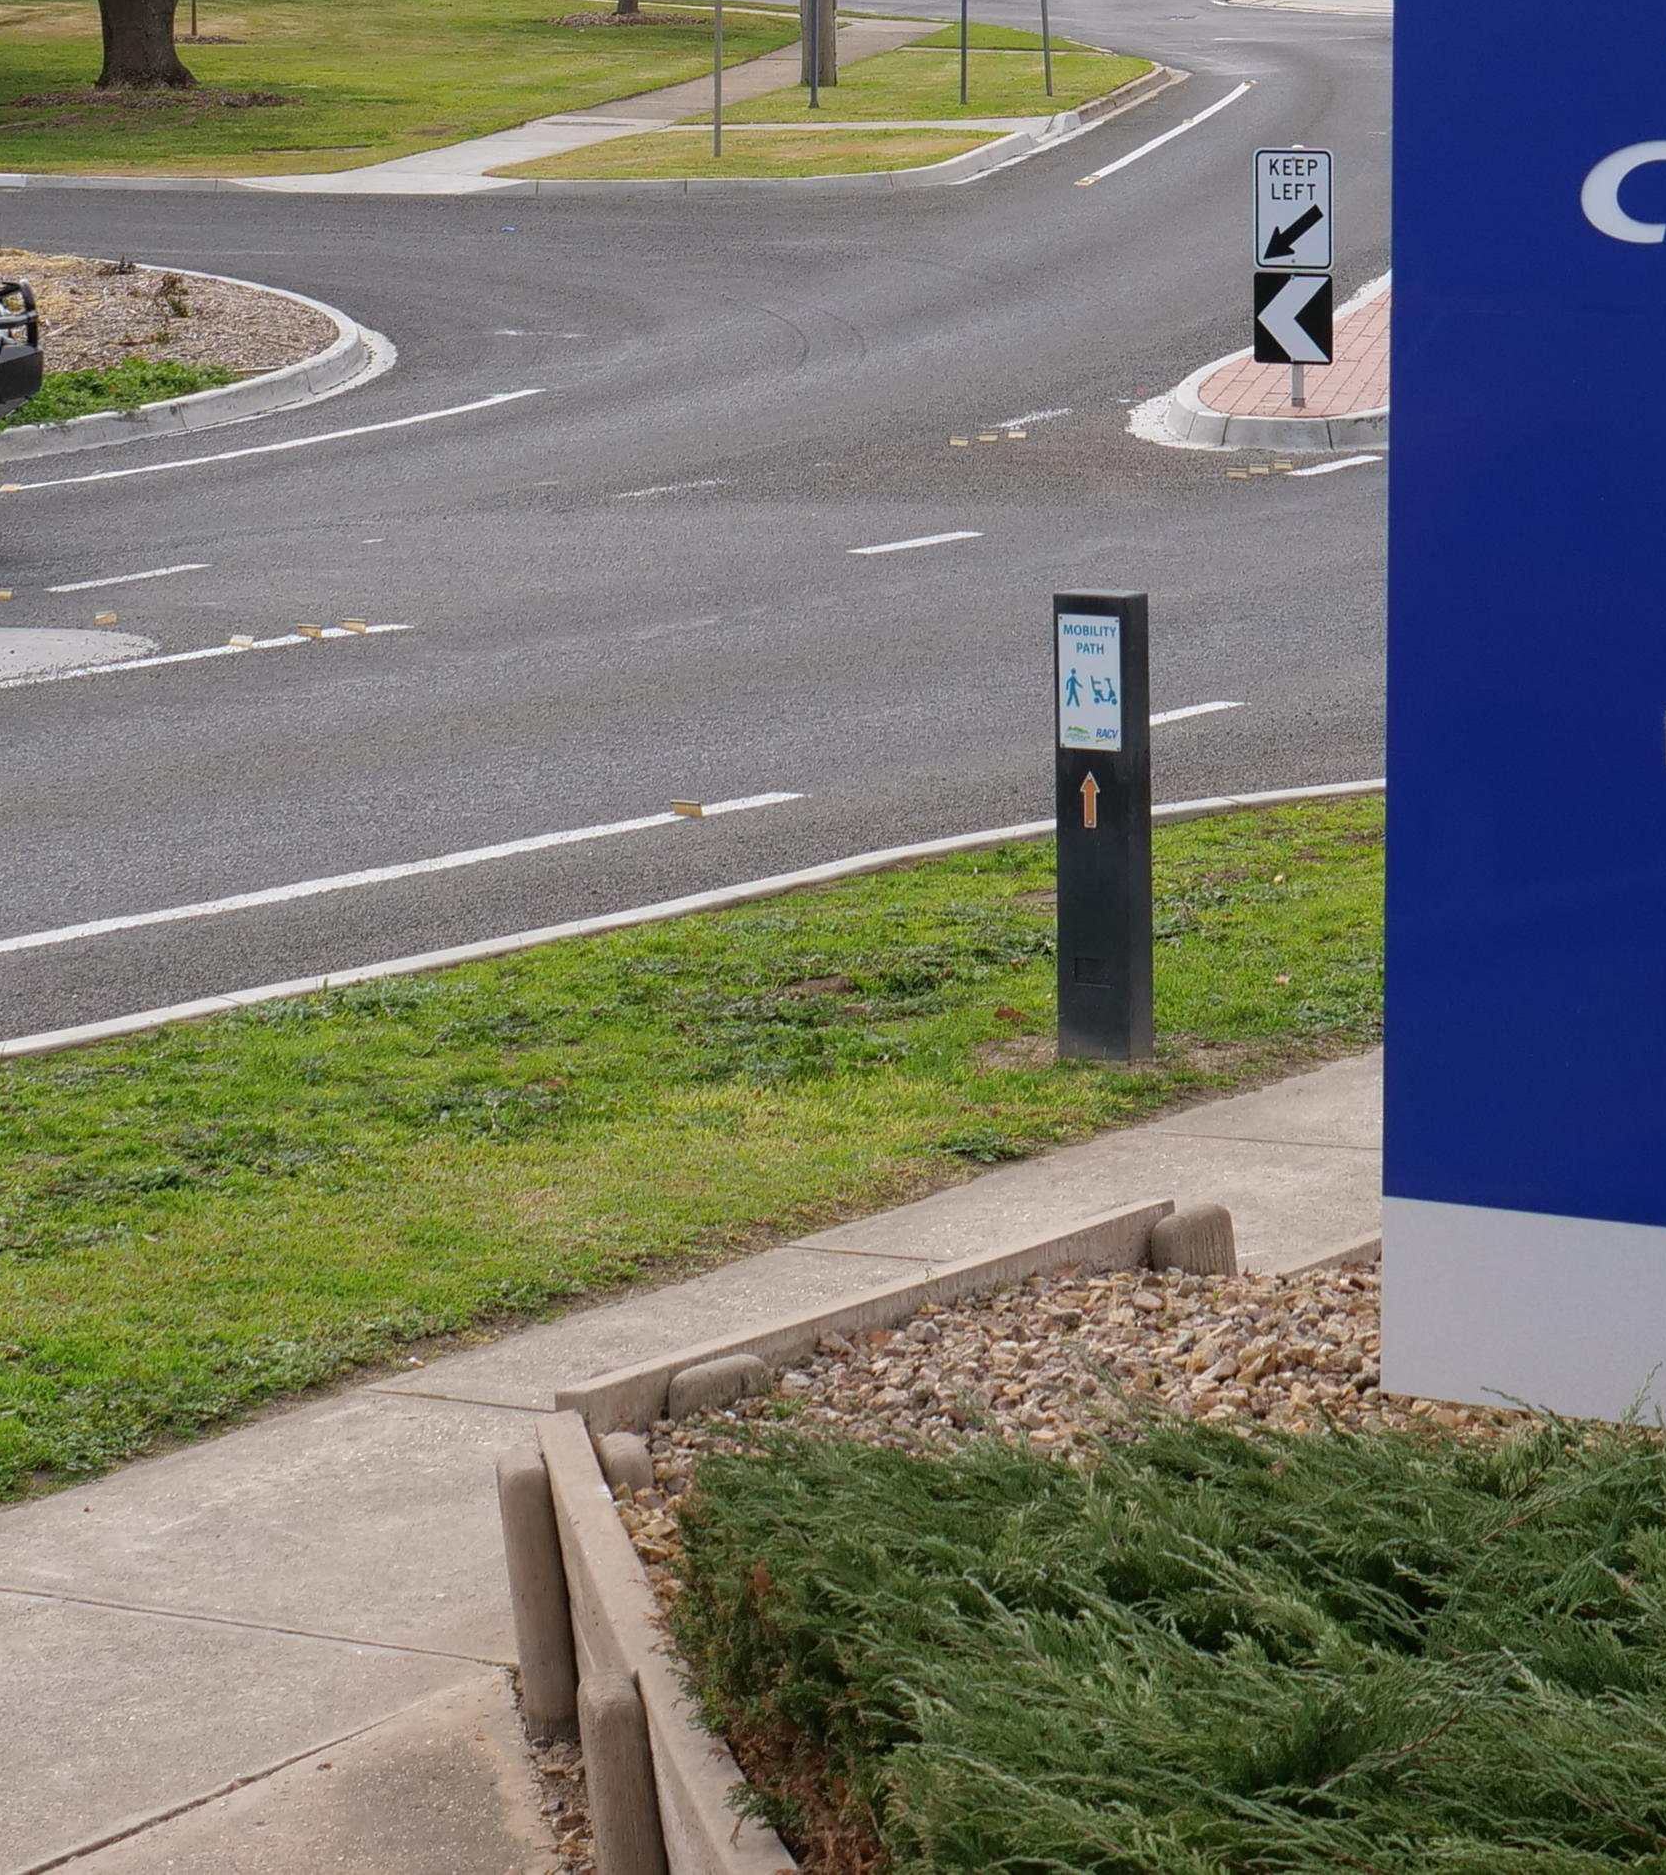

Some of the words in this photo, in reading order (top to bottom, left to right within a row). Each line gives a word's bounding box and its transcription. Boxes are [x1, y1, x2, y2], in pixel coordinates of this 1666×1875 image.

[1269, 158, 1318, 177] KEEP
[1270, 183, 1317, 201] LEFT
[1063, 623, 1117, 638] MOBILITY
[1076, 642, 1105, 655] PATH
[1095, 727, 1119, 740] RACV
